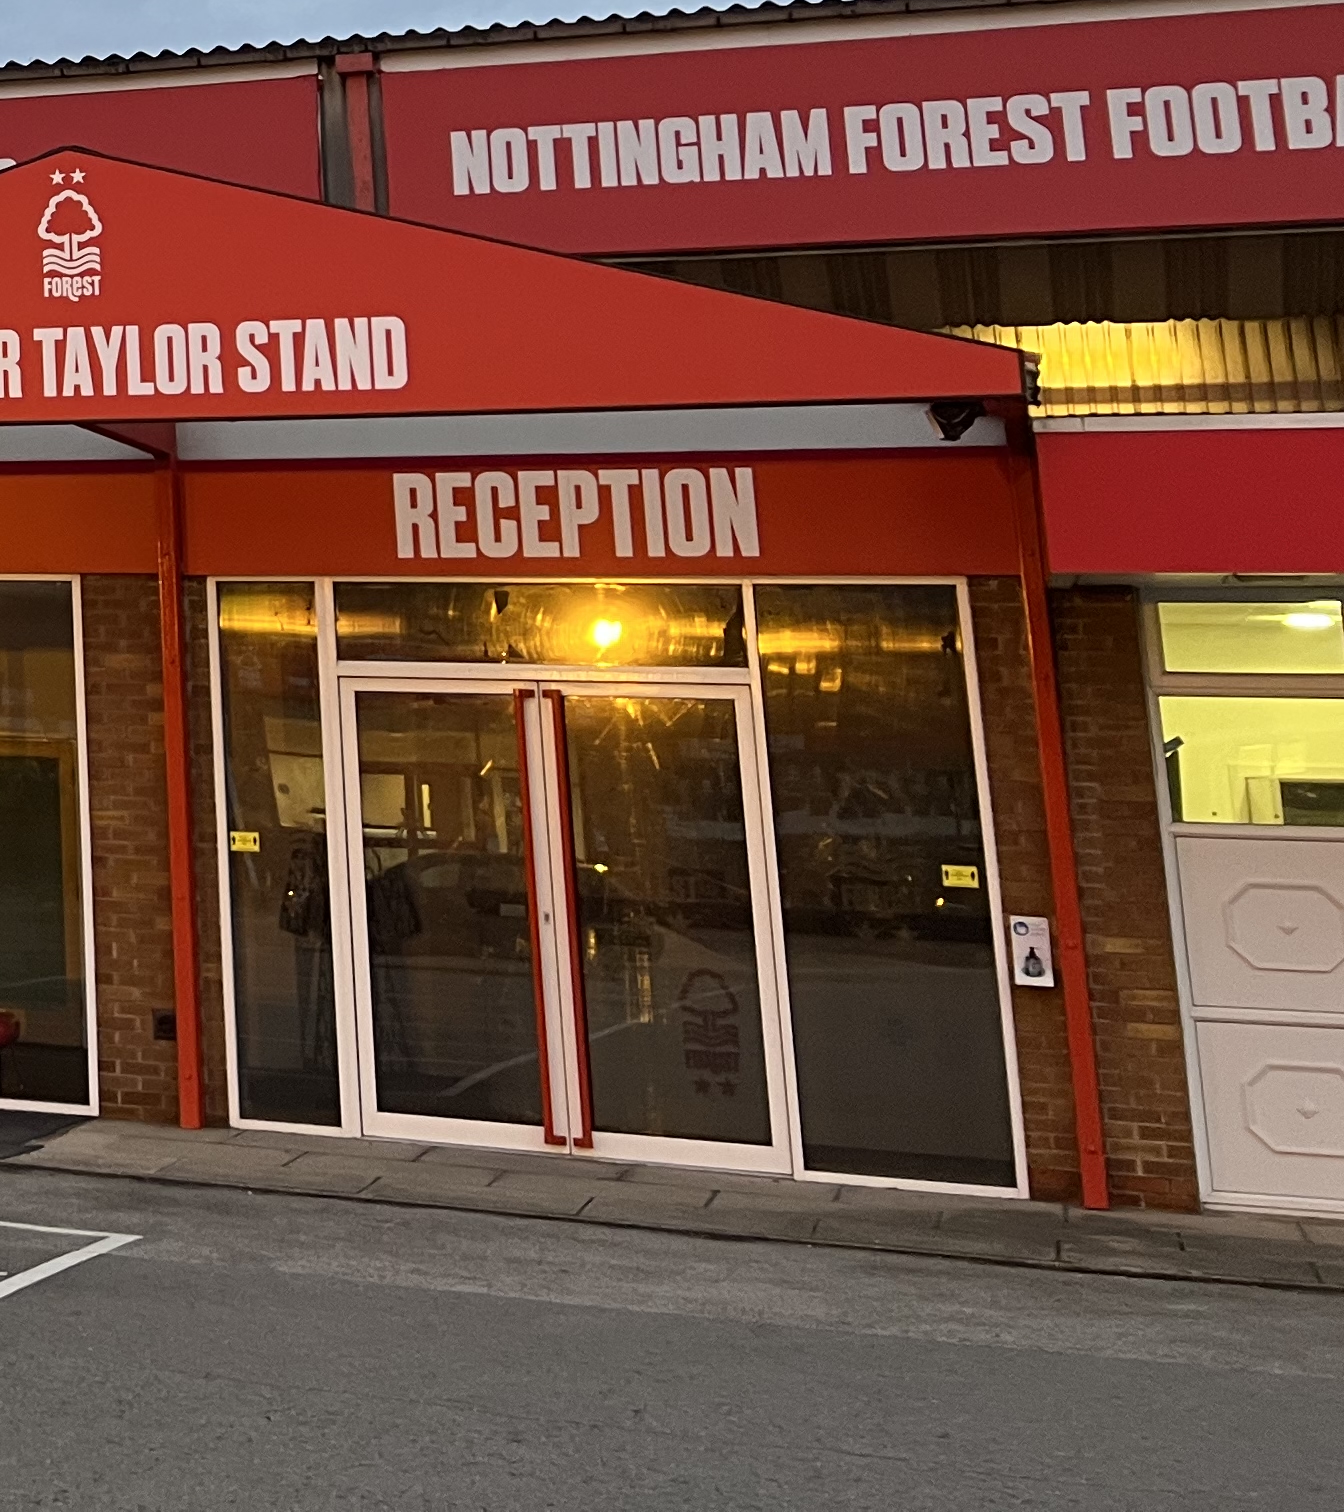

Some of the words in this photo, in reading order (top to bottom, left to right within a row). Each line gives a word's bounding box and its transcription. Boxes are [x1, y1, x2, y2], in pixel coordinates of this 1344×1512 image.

[450, 108, 832, 195] NOTTINGHAM
[844, 91, 1089, 173] FOREST
[1107, 75, 1344, 159] FOOTB
[33, 323, 223, 397] TAYLOR
[236, 317, 407, 392] STAND
[393, 468, 759, 558] RECEPTION
